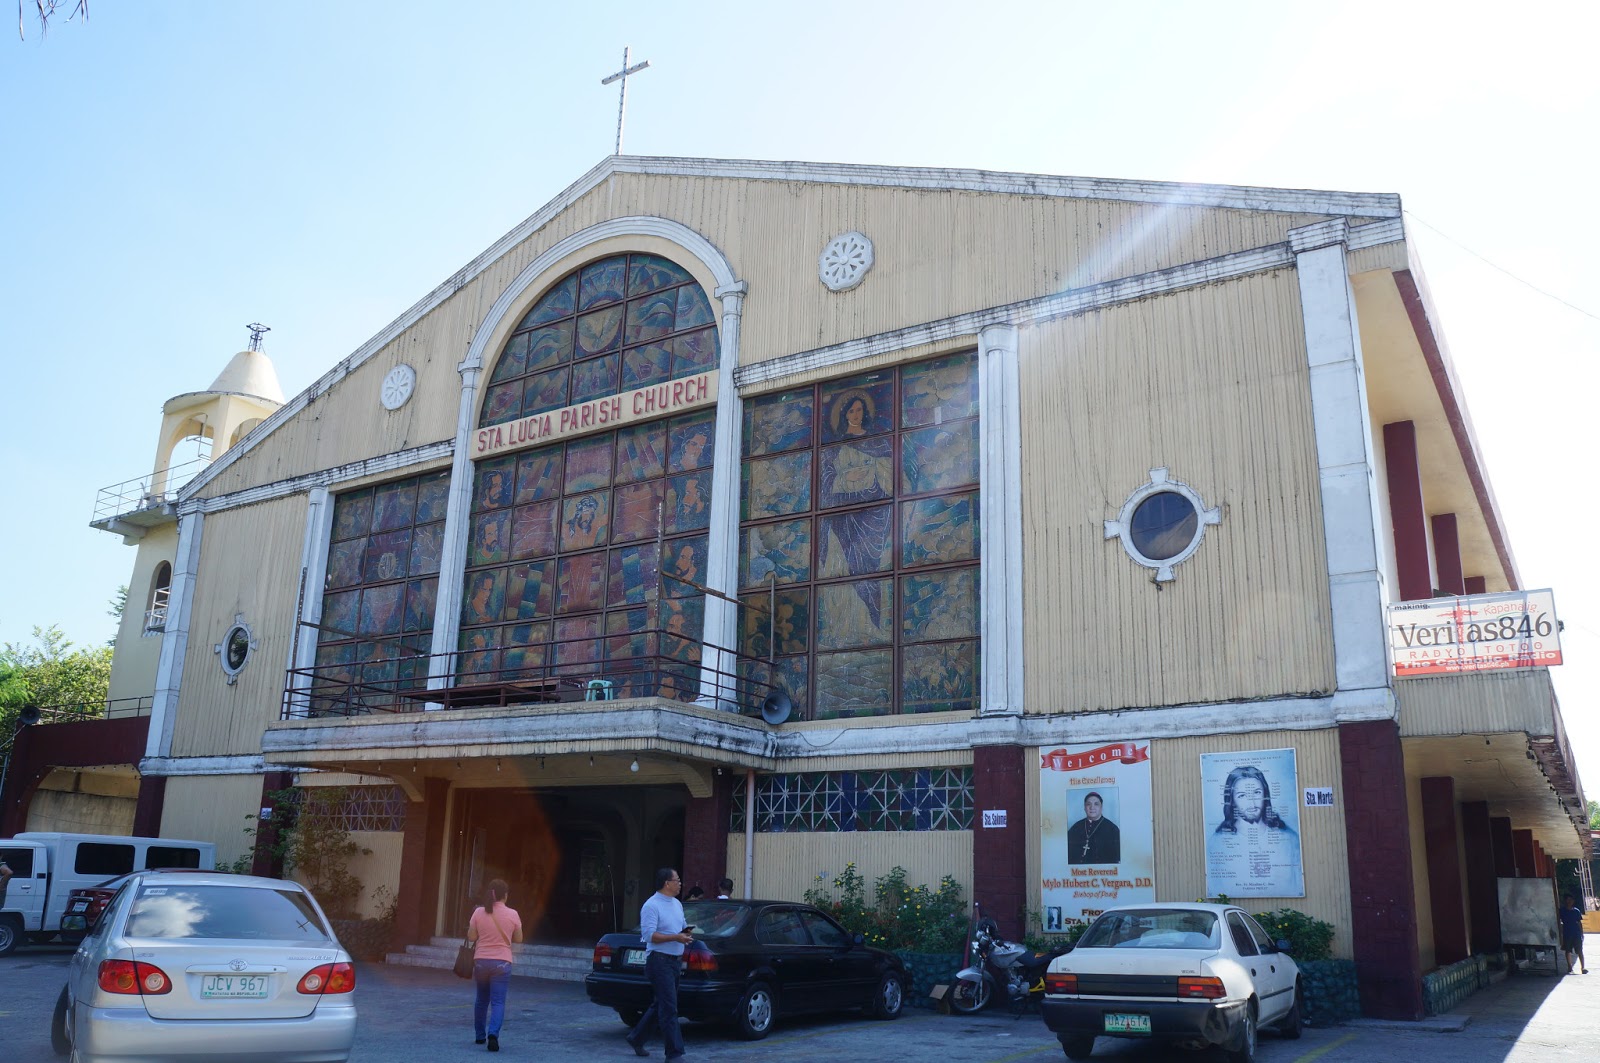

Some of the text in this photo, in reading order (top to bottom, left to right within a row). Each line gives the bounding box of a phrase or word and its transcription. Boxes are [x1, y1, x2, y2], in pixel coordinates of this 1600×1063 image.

[477, 375, 709, 452] STA. LUCIA PARISH CHURCH
[1409, 647, 1465, 659] RADYO
[1485, 642, 1542, 653] TOTOO
[1401, 660, 1430, 669] The
[1436, 655, 1504, 667] Catholic
[1052, 747, 1134, 768] Welcome
[1317, 791, 1333, 805] Marta
[1071, 867, 1118, 876] Most Reverend
[1042, 877, 1153, 890] Mylo Hubert C. Vergara, D.D.
[207, 977, 264, 991] JCV 967
